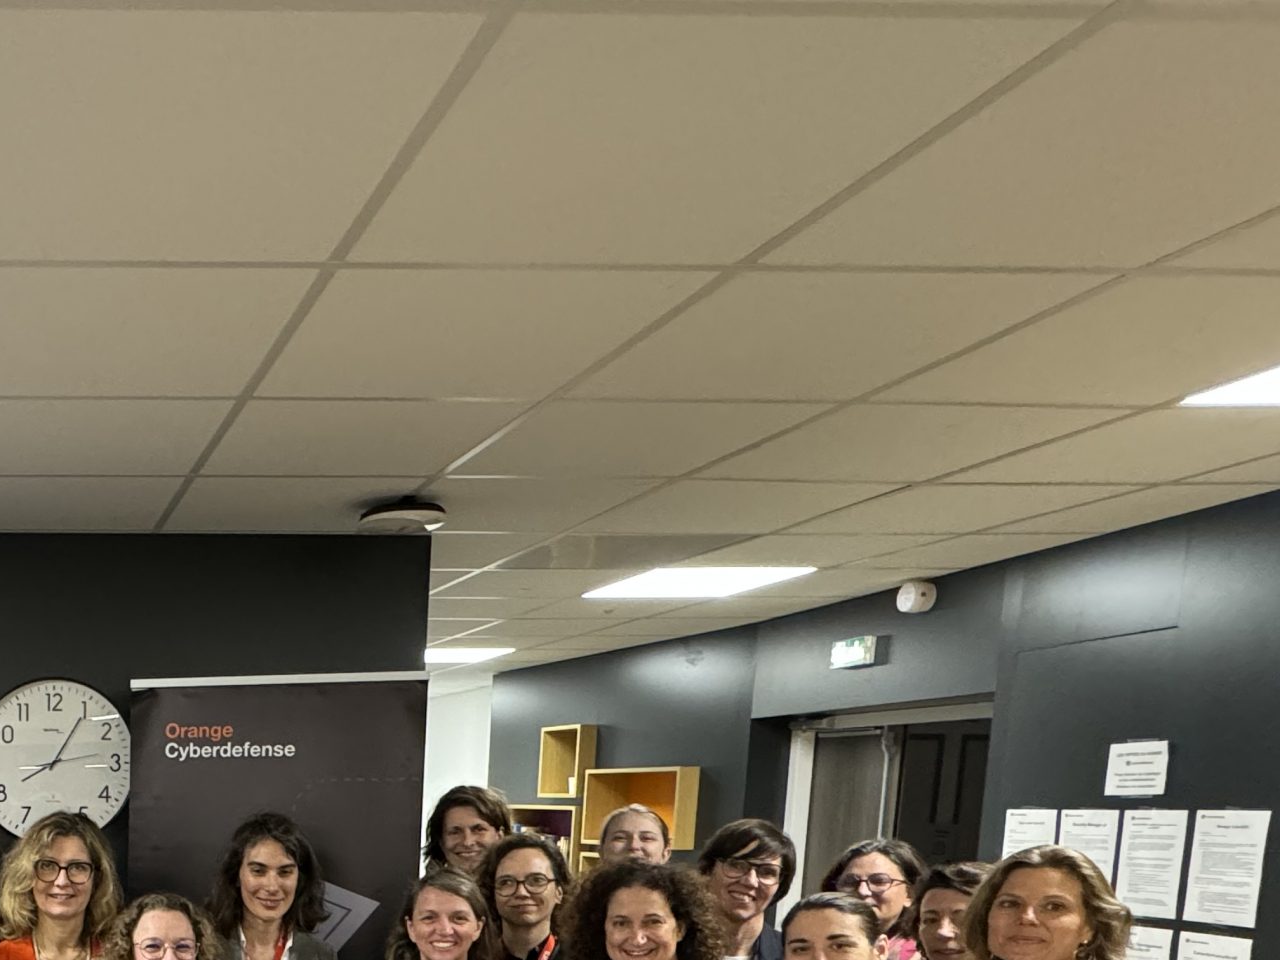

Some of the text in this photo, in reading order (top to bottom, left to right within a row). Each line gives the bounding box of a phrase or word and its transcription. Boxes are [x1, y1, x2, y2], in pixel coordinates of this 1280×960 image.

[45, 693, 63, 711] 12
[81, 701, 87, 719] 1
[17, 703, 30, 722] 11
[101, 722, 112, 741] 2
[165, 722, 234, 741] Orange
[165, 741, 296, 761] Cyberdefense
[109, 753, 121, 772] 3
[98, 785, 111, 803] 4
[21, 806, 31, 824] 7
